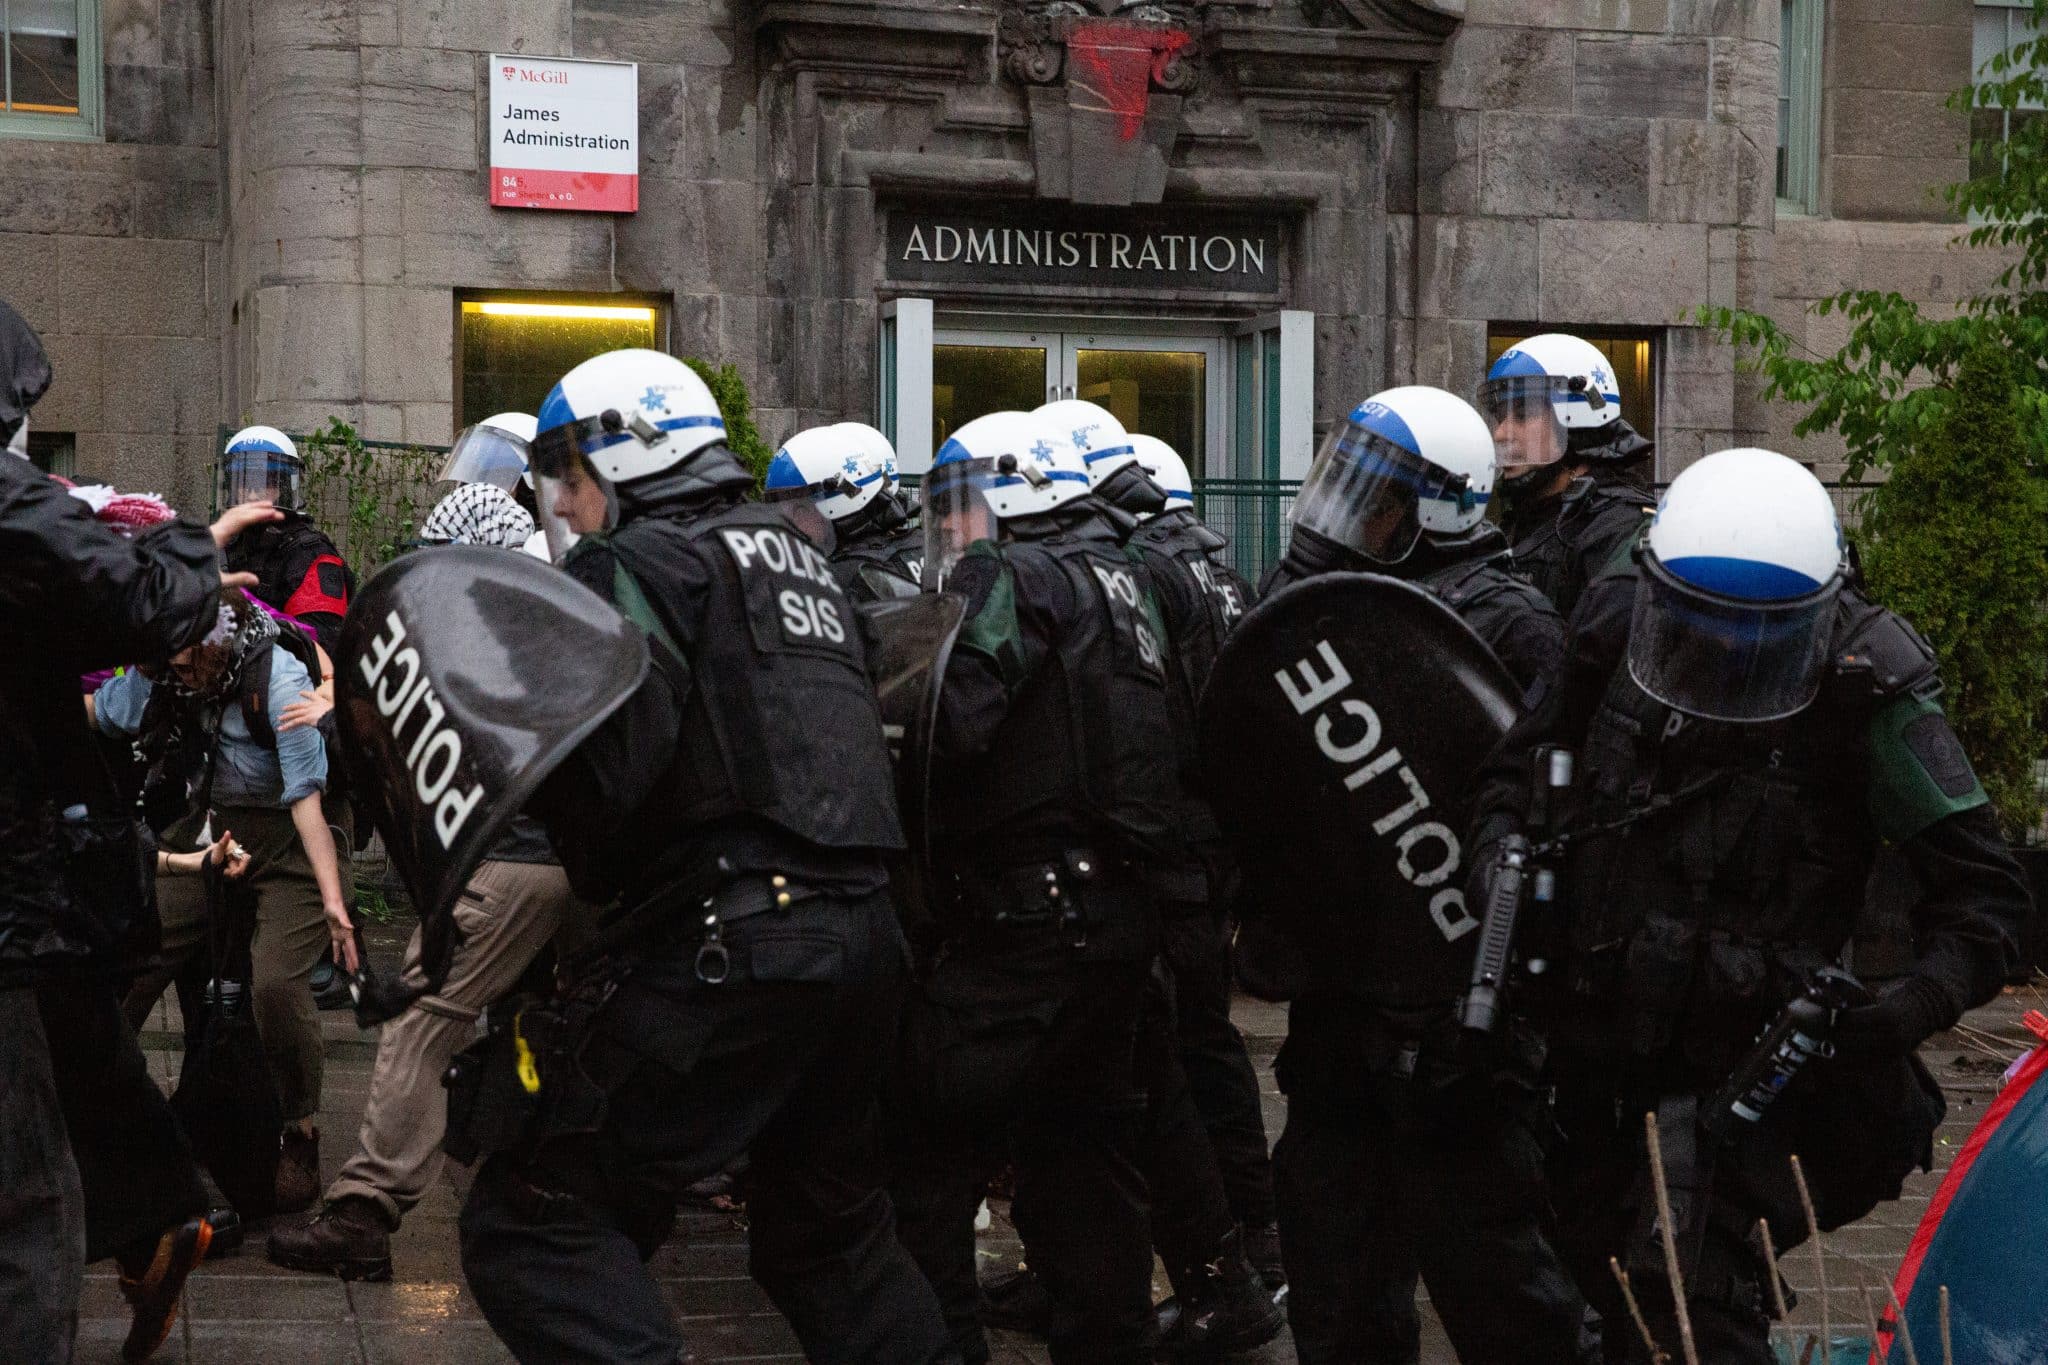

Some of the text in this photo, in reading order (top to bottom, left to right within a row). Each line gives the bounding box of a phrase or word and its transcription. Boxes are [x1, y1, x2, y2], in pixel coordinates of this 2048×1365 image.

[519, 69, 568, 85] McGill
[503, 104, 560, 122] James
[503, 129, 630, 151] Administration
[902, 223, 1265, 275] ADMINISTRATION
[779, 590, 845, 643] SIS
[1093, 565, 1150, 619] POL
[360, 609, 485, 850] POLICE
[1274, 639, 1481, 942] POLICE
